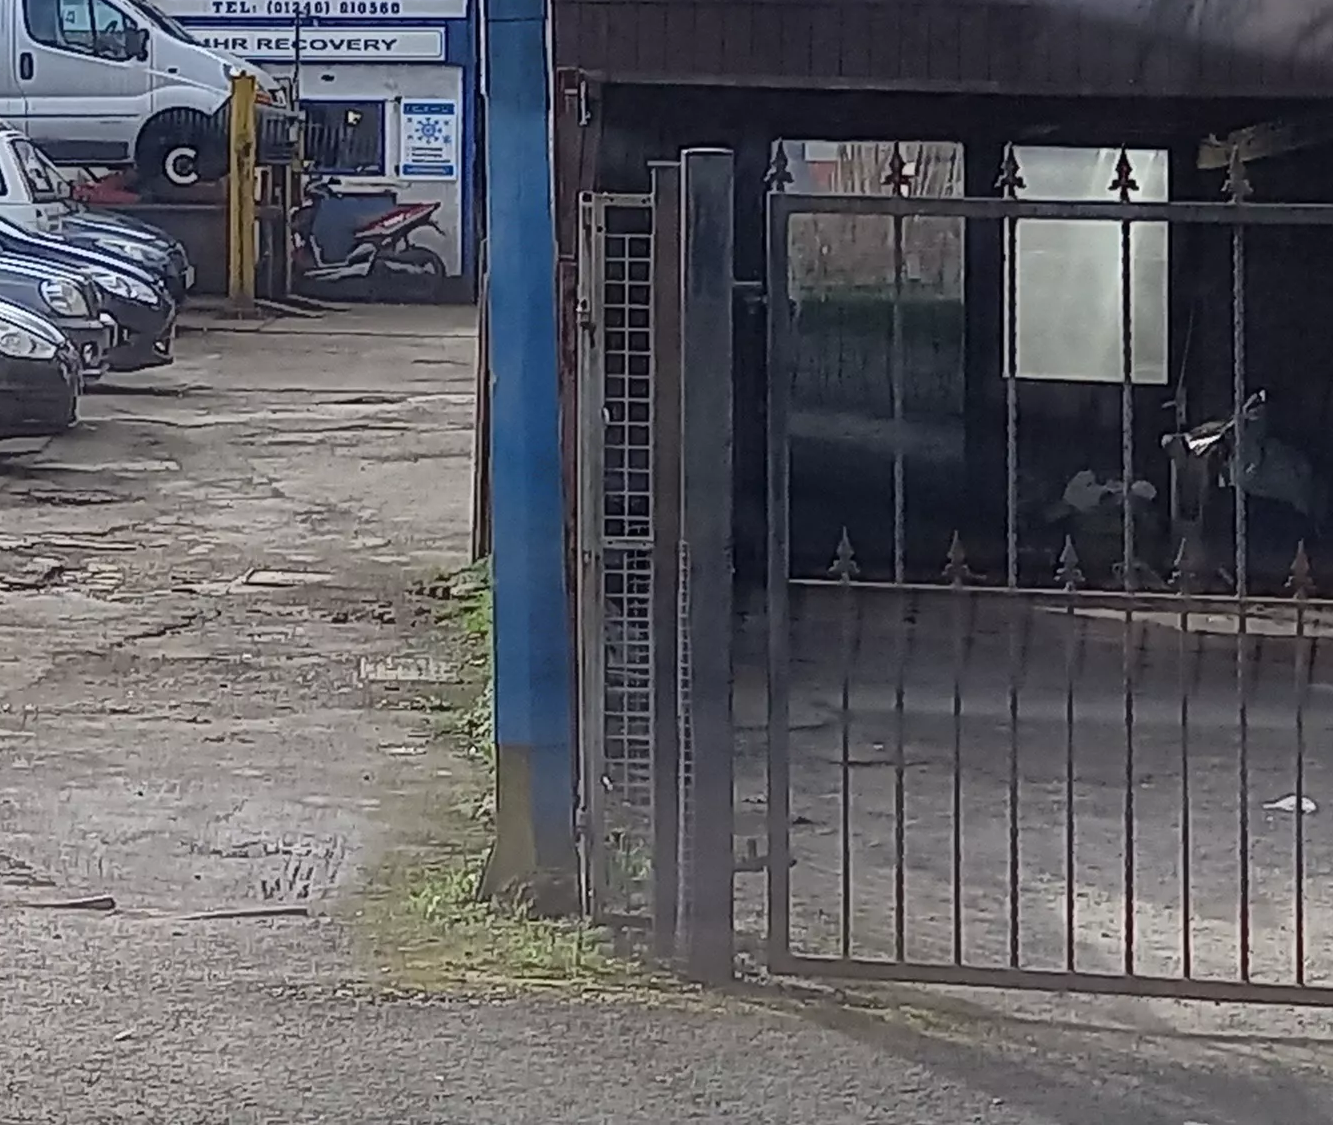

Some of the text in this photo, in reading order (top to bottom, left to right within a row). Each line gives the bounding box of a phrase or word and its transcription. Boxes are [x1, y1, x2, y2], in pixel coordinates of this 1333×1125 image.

[212, 1, 257, 14] TEL:
[203, 38, 398, 51] 4HR RECOVERY
